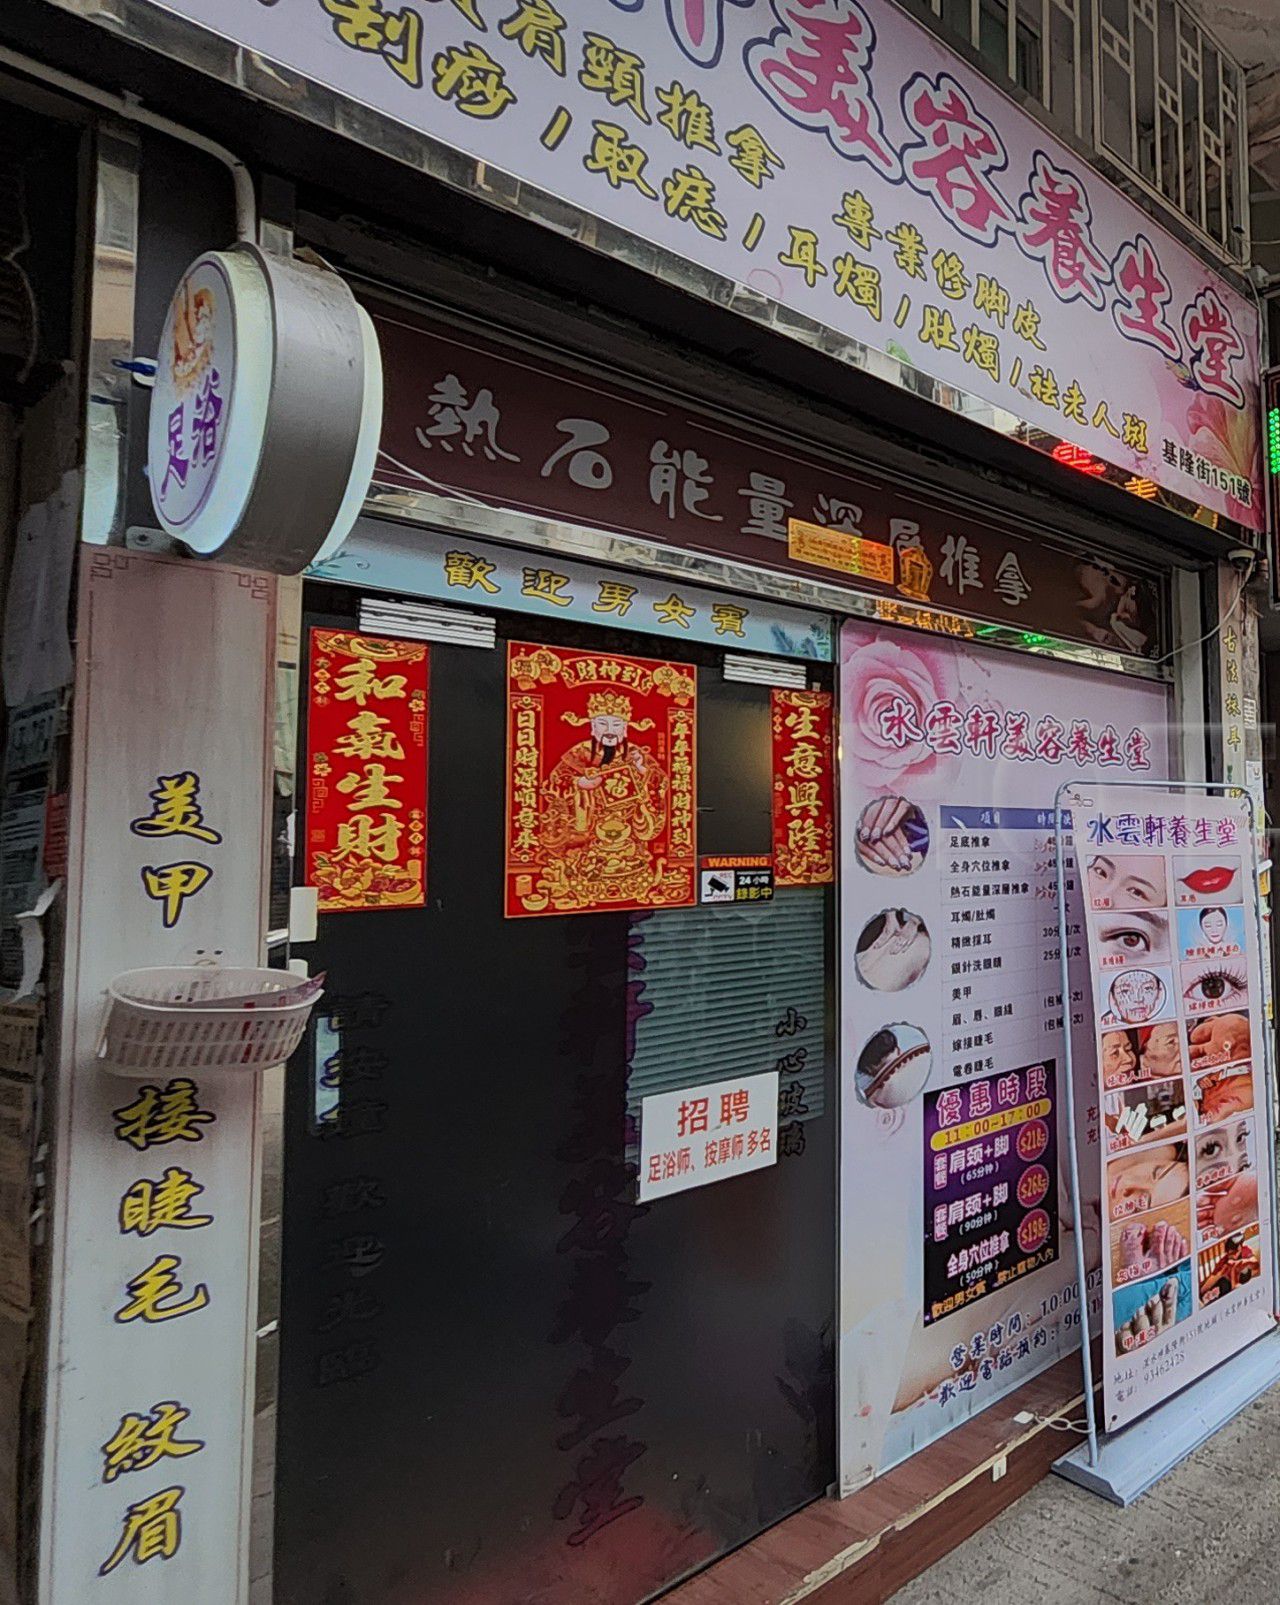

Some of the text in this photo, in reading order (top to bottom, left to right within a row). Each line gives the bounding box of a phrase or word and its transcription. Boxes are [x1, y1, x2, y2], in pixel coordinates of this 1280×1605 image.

[606, 0, 1246, 408] 美容養生堂
[1161, 437, 1253, 508] 基隆街151號
[443, 550, 749, 639] 歡迎男女賓
[577, 658, 641, 689] 財神到
[332, 658, 408, 862] 和氣生財
[878, 697, 1151, 771] 水雲軒美容養生堂
[782, 707, 824, 851] 生意興隆
[130, 771, 222, 928] 美甲
[708, 856, 768, 868] WARNING
[1086, 812, 1237, 847] 水雲軒養生堂
[677, 1088, 750, 1138] 招聘
[936, 1064, 1047, 1128] 優惠時段
[115, 1078, 216, 1324] 接睫毛
[99, 1401, 205, 1577] 紋眉
